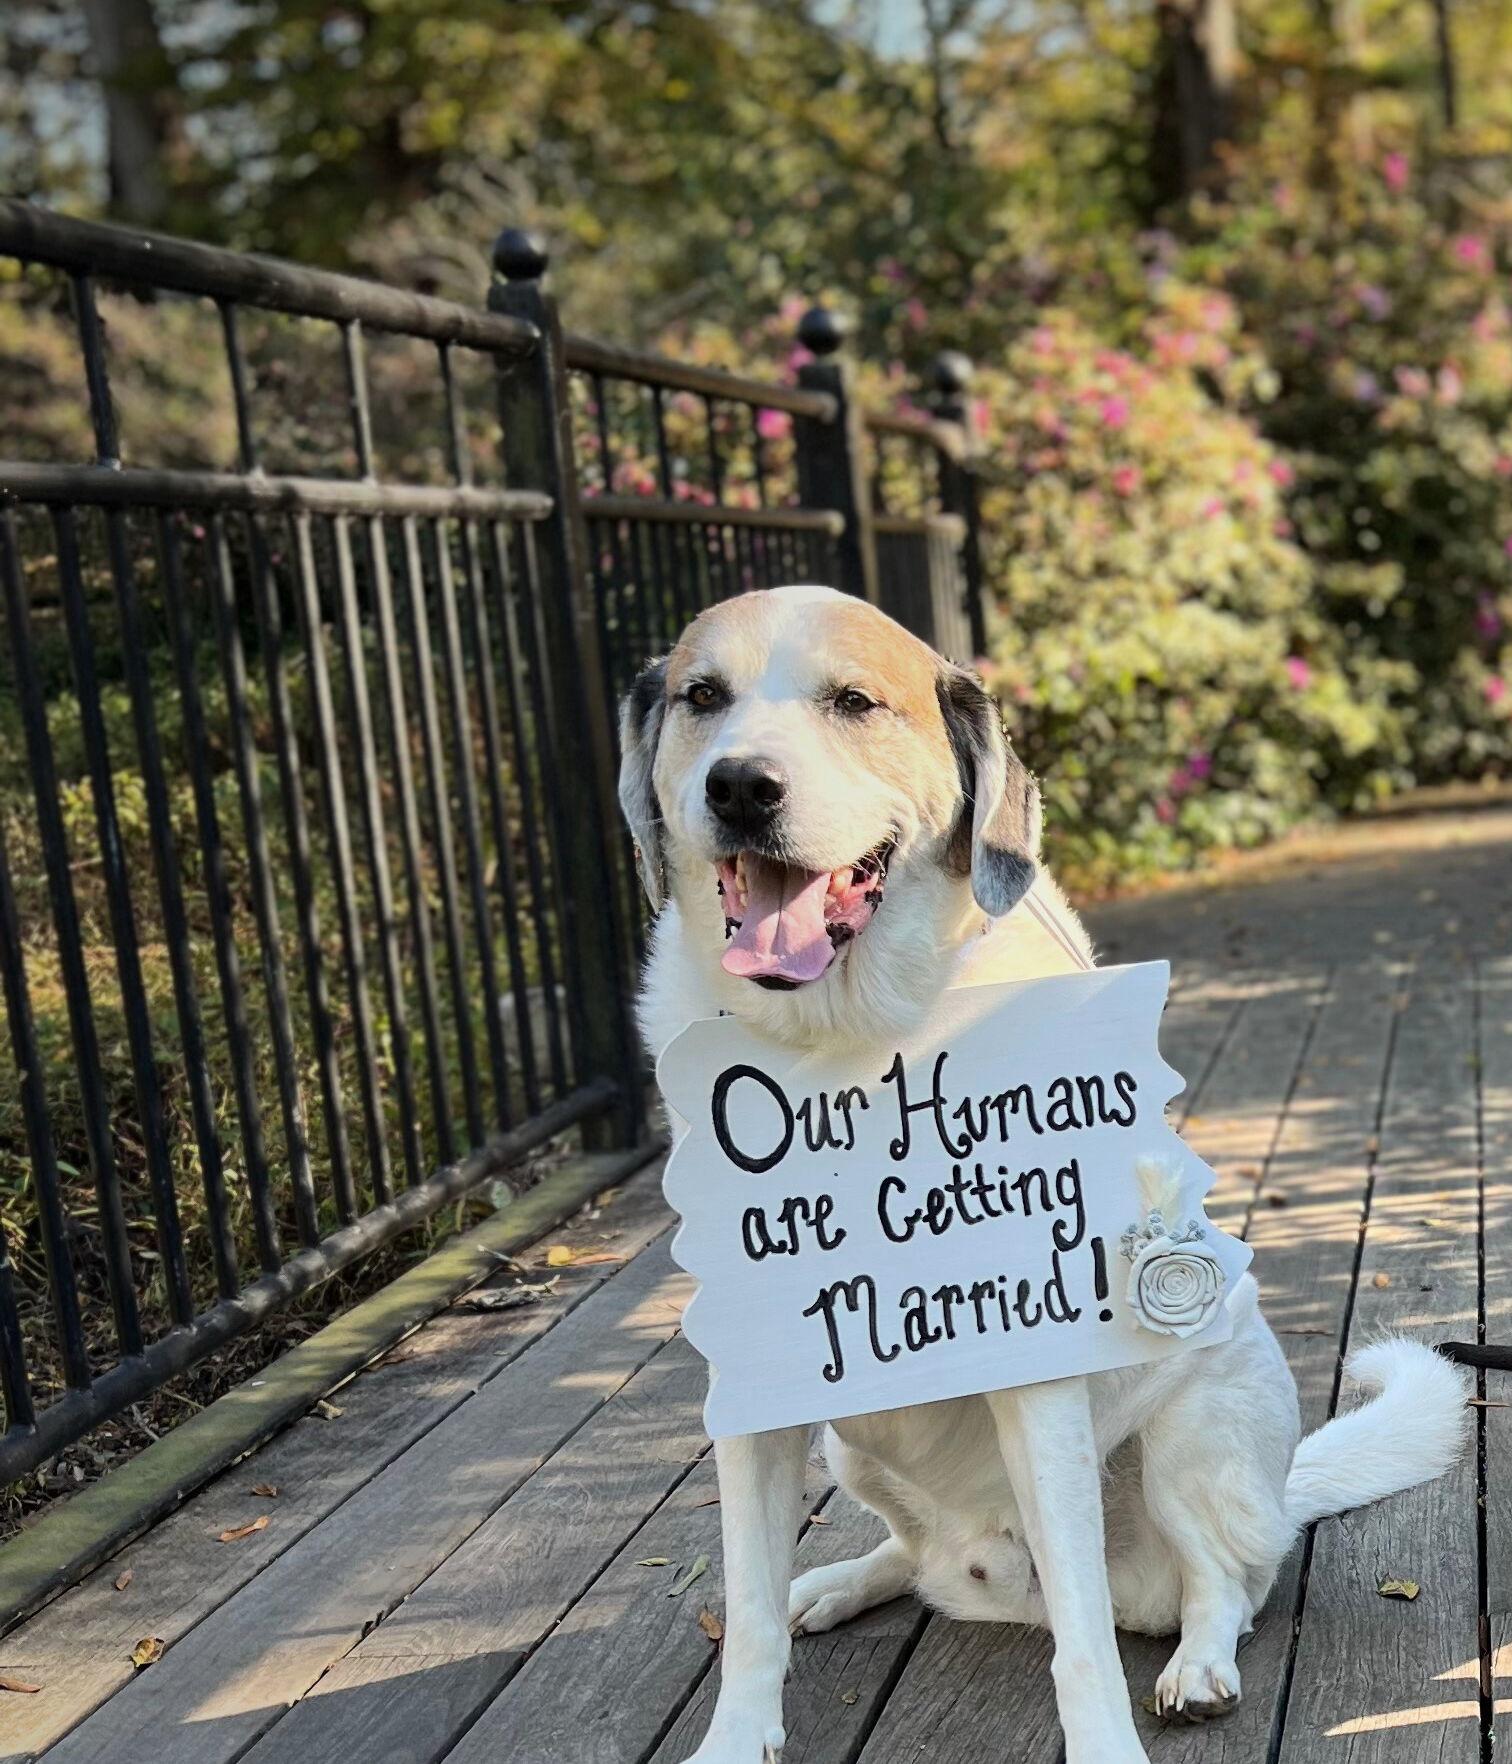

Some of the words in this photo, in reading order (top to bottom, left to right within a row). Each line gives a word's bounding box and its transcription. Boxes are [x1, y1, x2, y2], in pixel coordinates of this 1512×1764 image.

[711, 1063, 870, 1174] Our
[881, 1051, 1139, 1160] Humans
[742, 1193, 846, 1261] are
[877, 1158, 1086, 1252] Getting
[803, 1236, 1114, 1383] Married!
